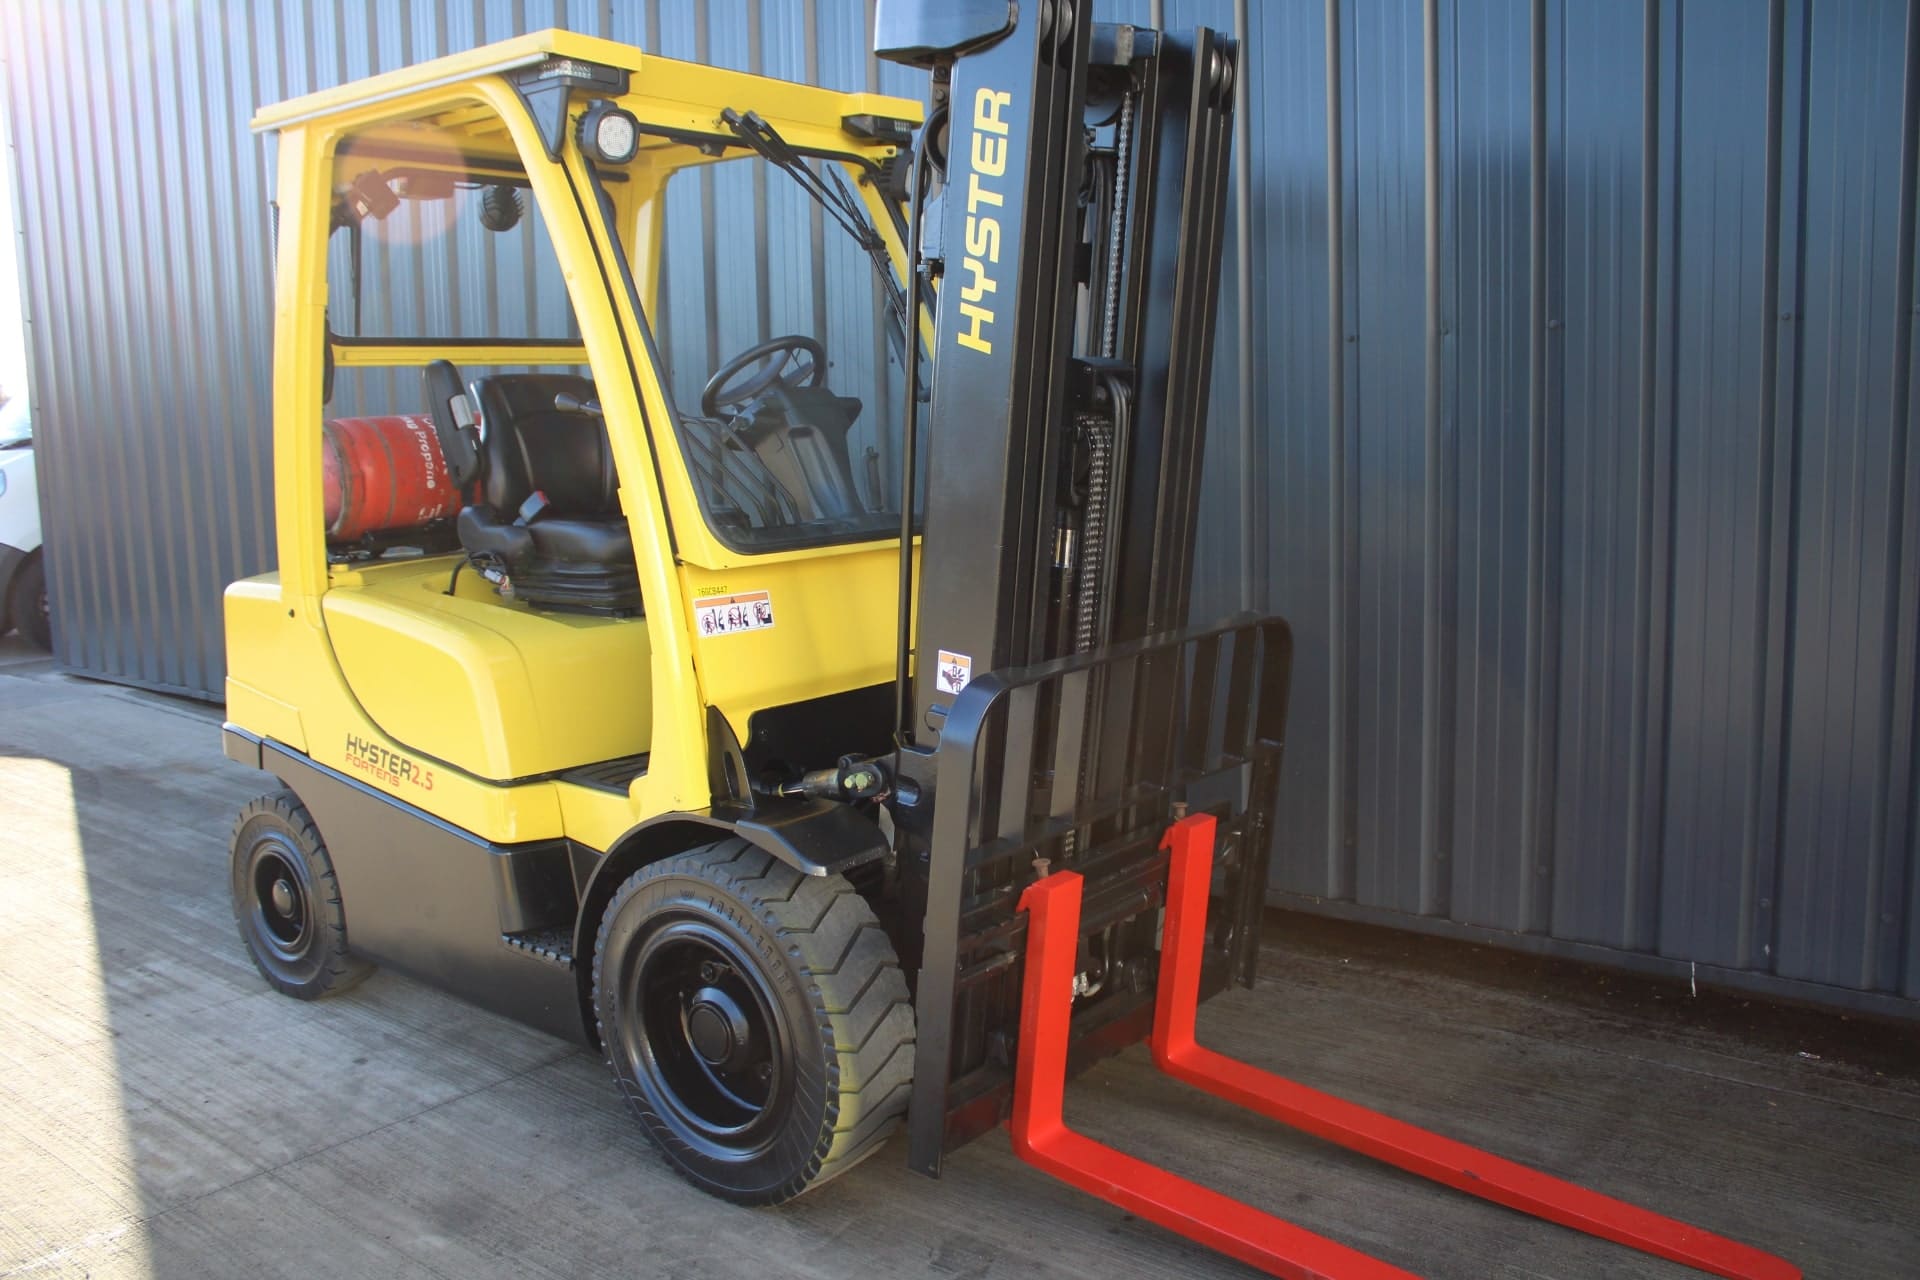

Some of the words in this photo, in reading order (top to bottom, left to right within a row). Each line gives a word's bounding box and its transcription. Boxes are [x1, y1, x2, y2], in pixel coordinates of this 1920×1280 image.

[957, 87, 1011, 355] HYSTER
[345, 752, 400, 787] FORTENS
[346, 732, 412, 781] HYSTER
[411, 764, 433, 791] 2.5
